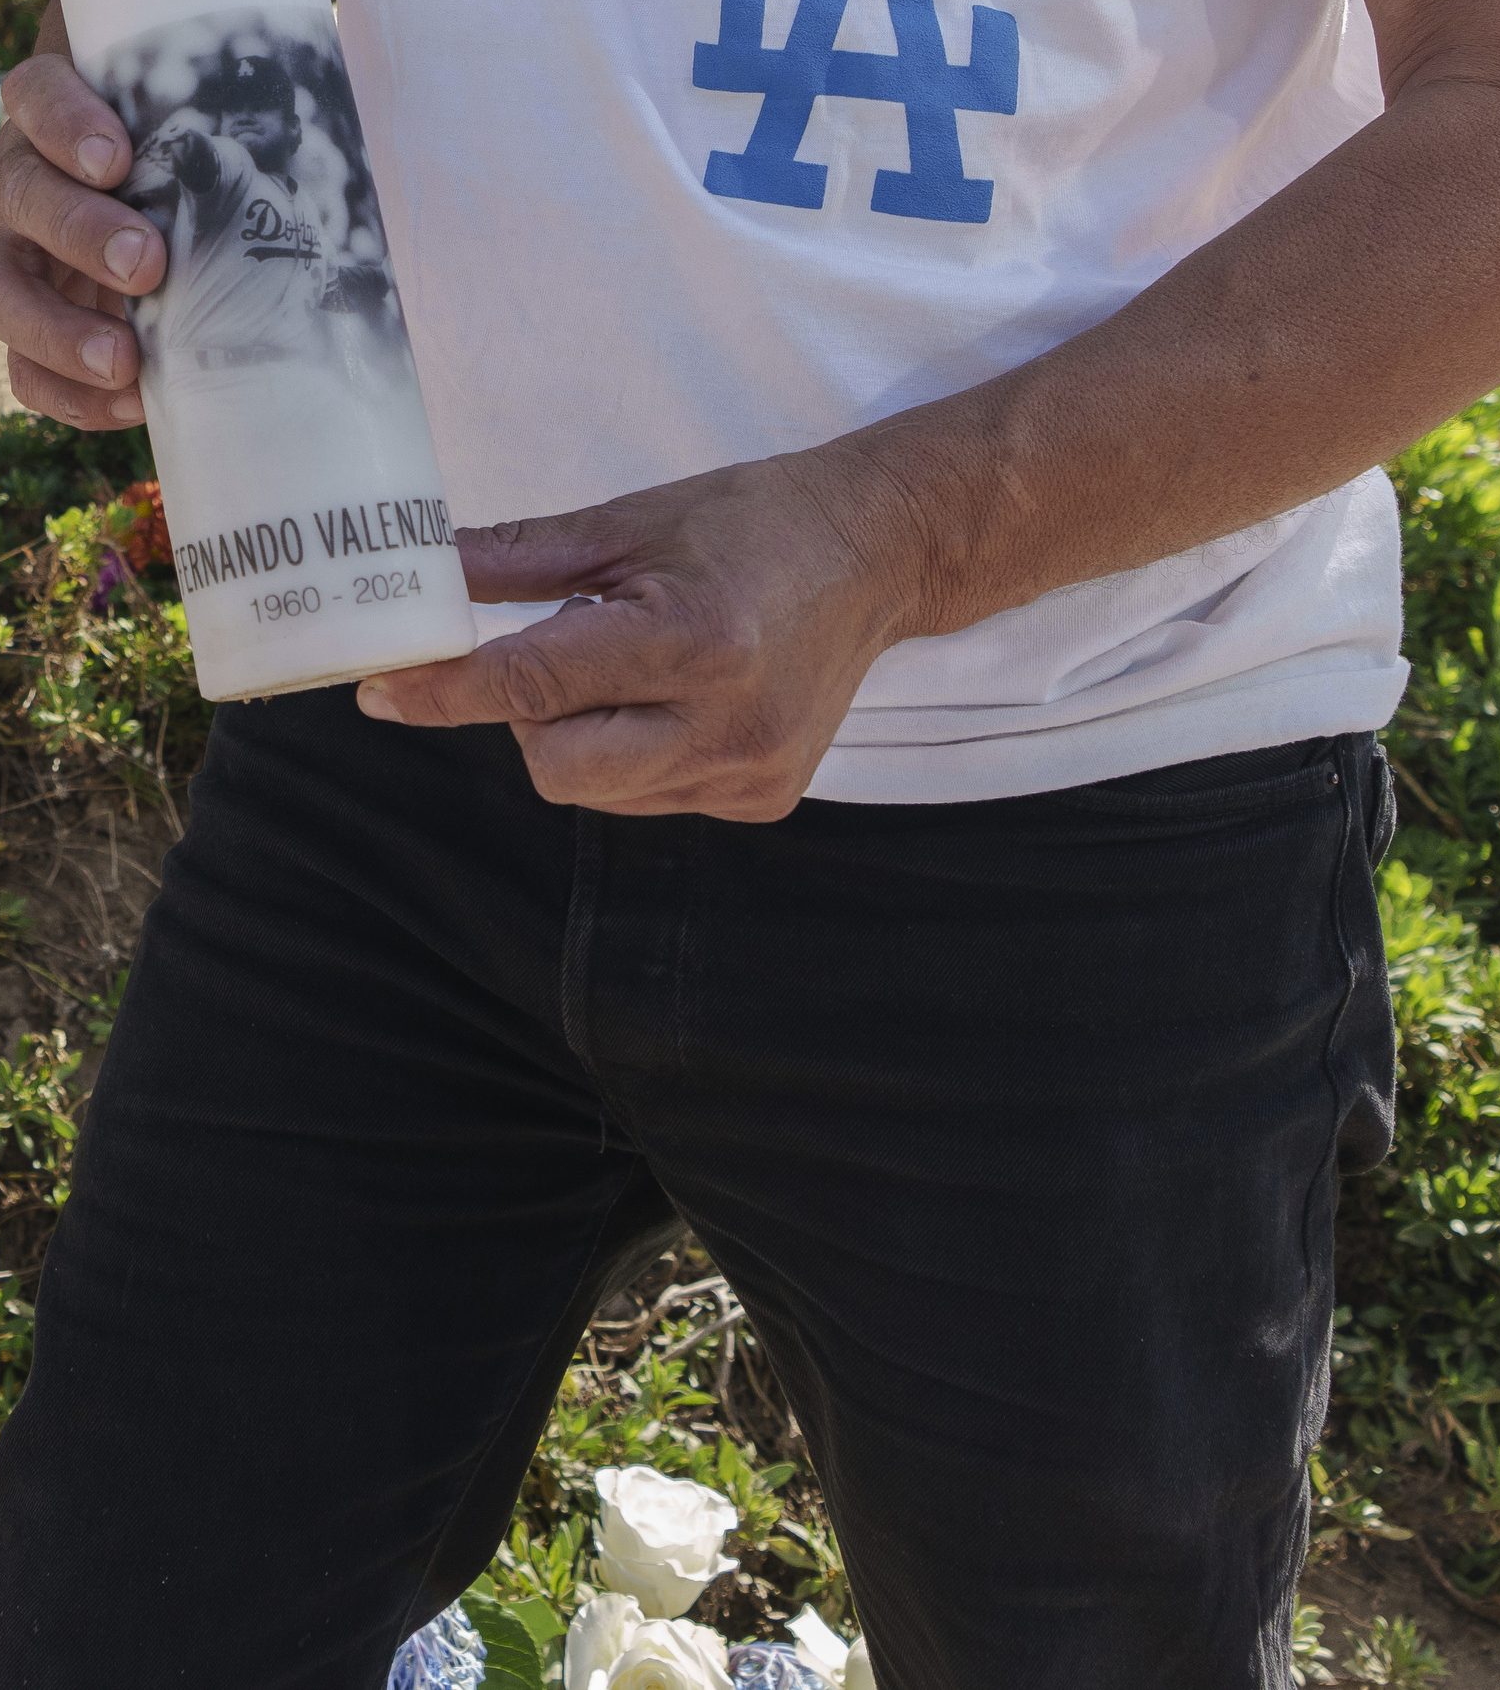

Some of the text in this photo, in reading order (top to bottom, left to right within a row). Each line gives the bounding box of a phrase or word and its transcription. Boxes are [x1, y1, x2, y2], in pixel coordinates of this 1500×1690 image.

[175, 517, 304, 596] FERNANDO
[250, 586, 321, 624] 1960
[353, 570, 422, 605] 2024
